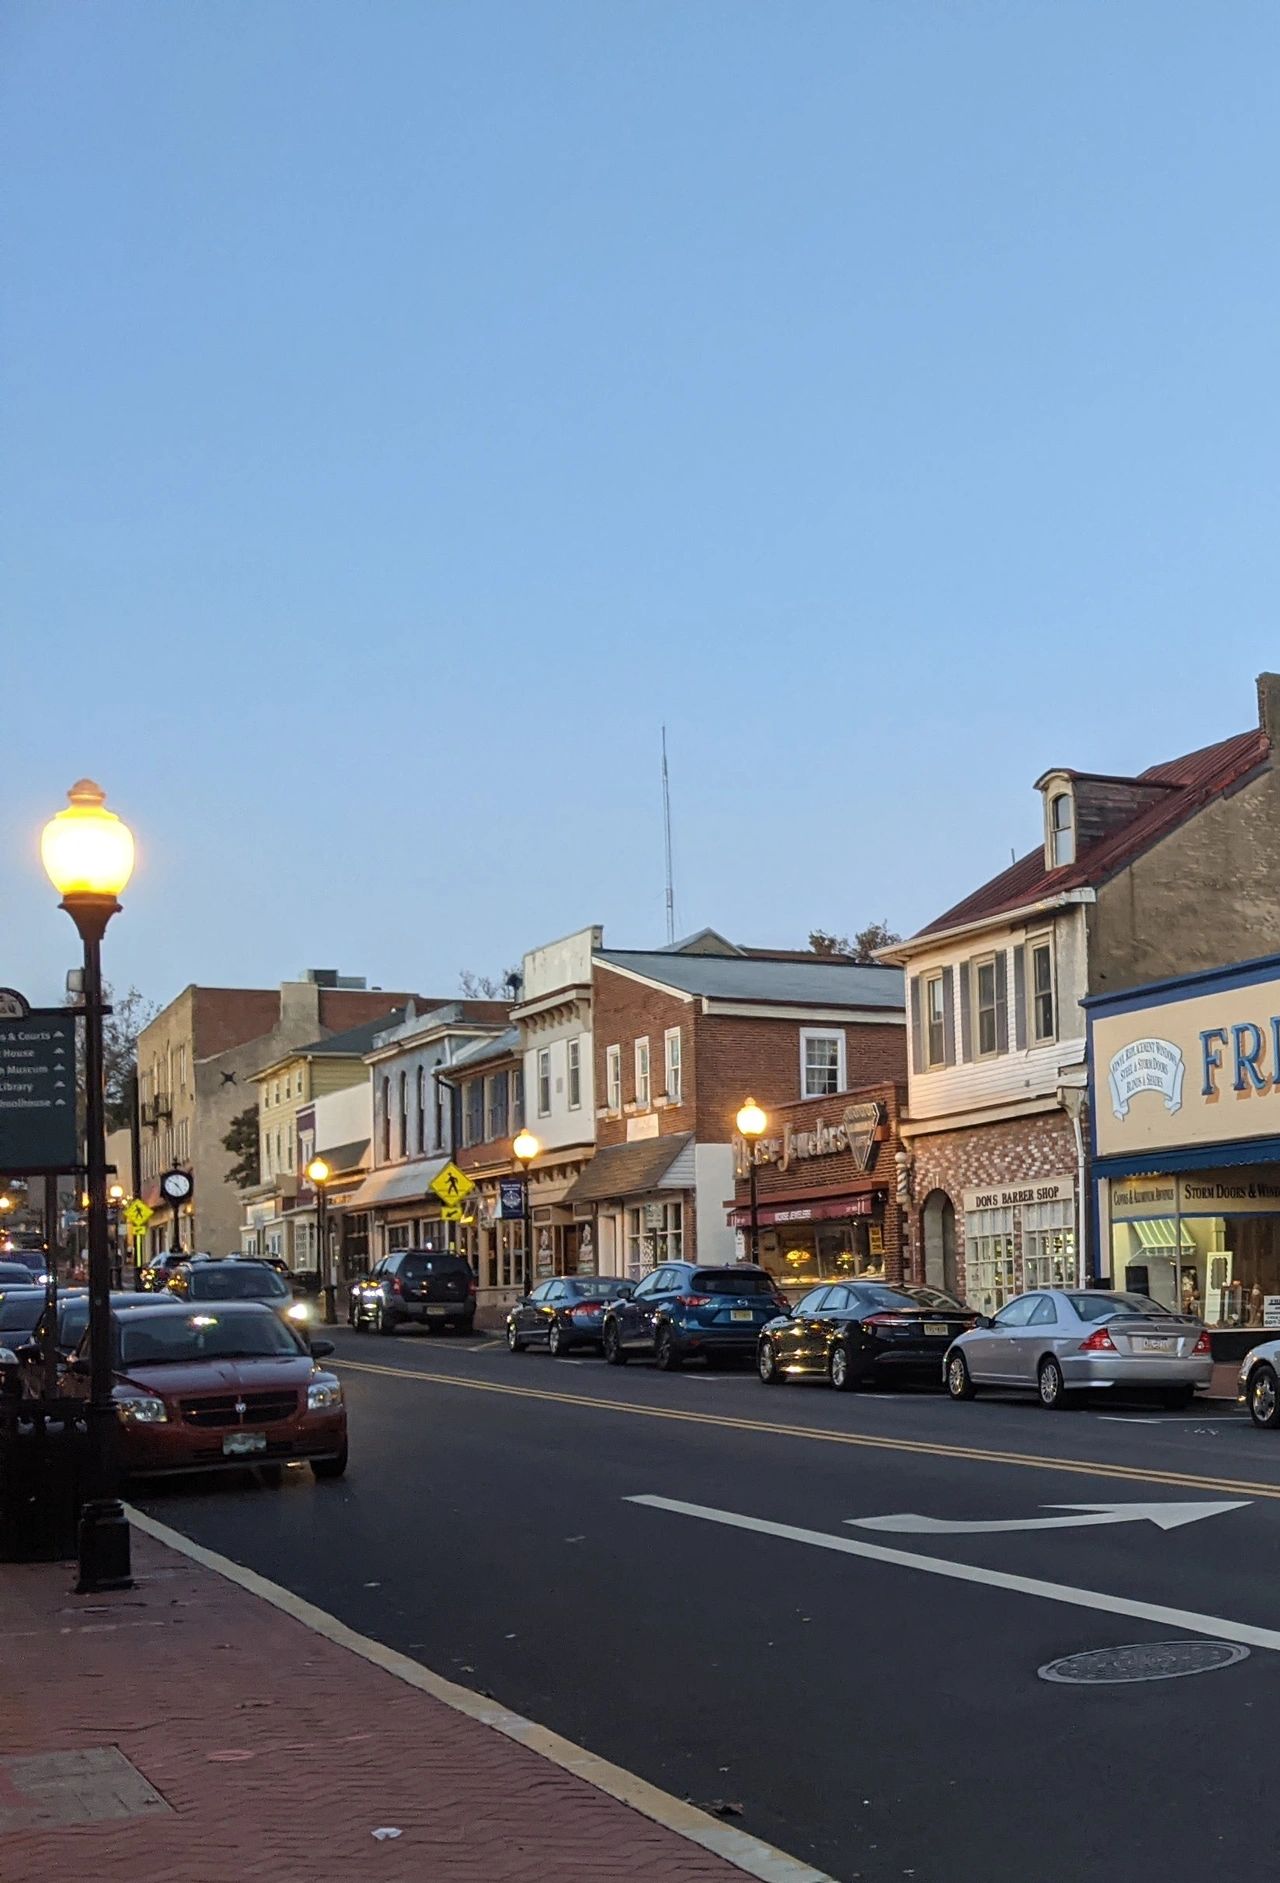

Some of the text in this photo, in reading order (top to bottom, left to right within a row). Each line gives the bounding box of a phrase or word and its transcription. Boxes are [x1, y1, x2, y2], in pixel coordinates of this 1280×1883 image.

[18, 1031, 51, 1040] Courts
[3, 1049, 35, 1057] House
[7, 1065, 49, 1074] Museum
[1001, 1189, 1034, 1204] BARBER
[1036, 1186, 1060, 1200] SHOP
[1185, 1184, 1214, 1200] STORM
[1216, 1183, 1246, 1199] DOORS
[1248, 1183, 1257, 1198] &
